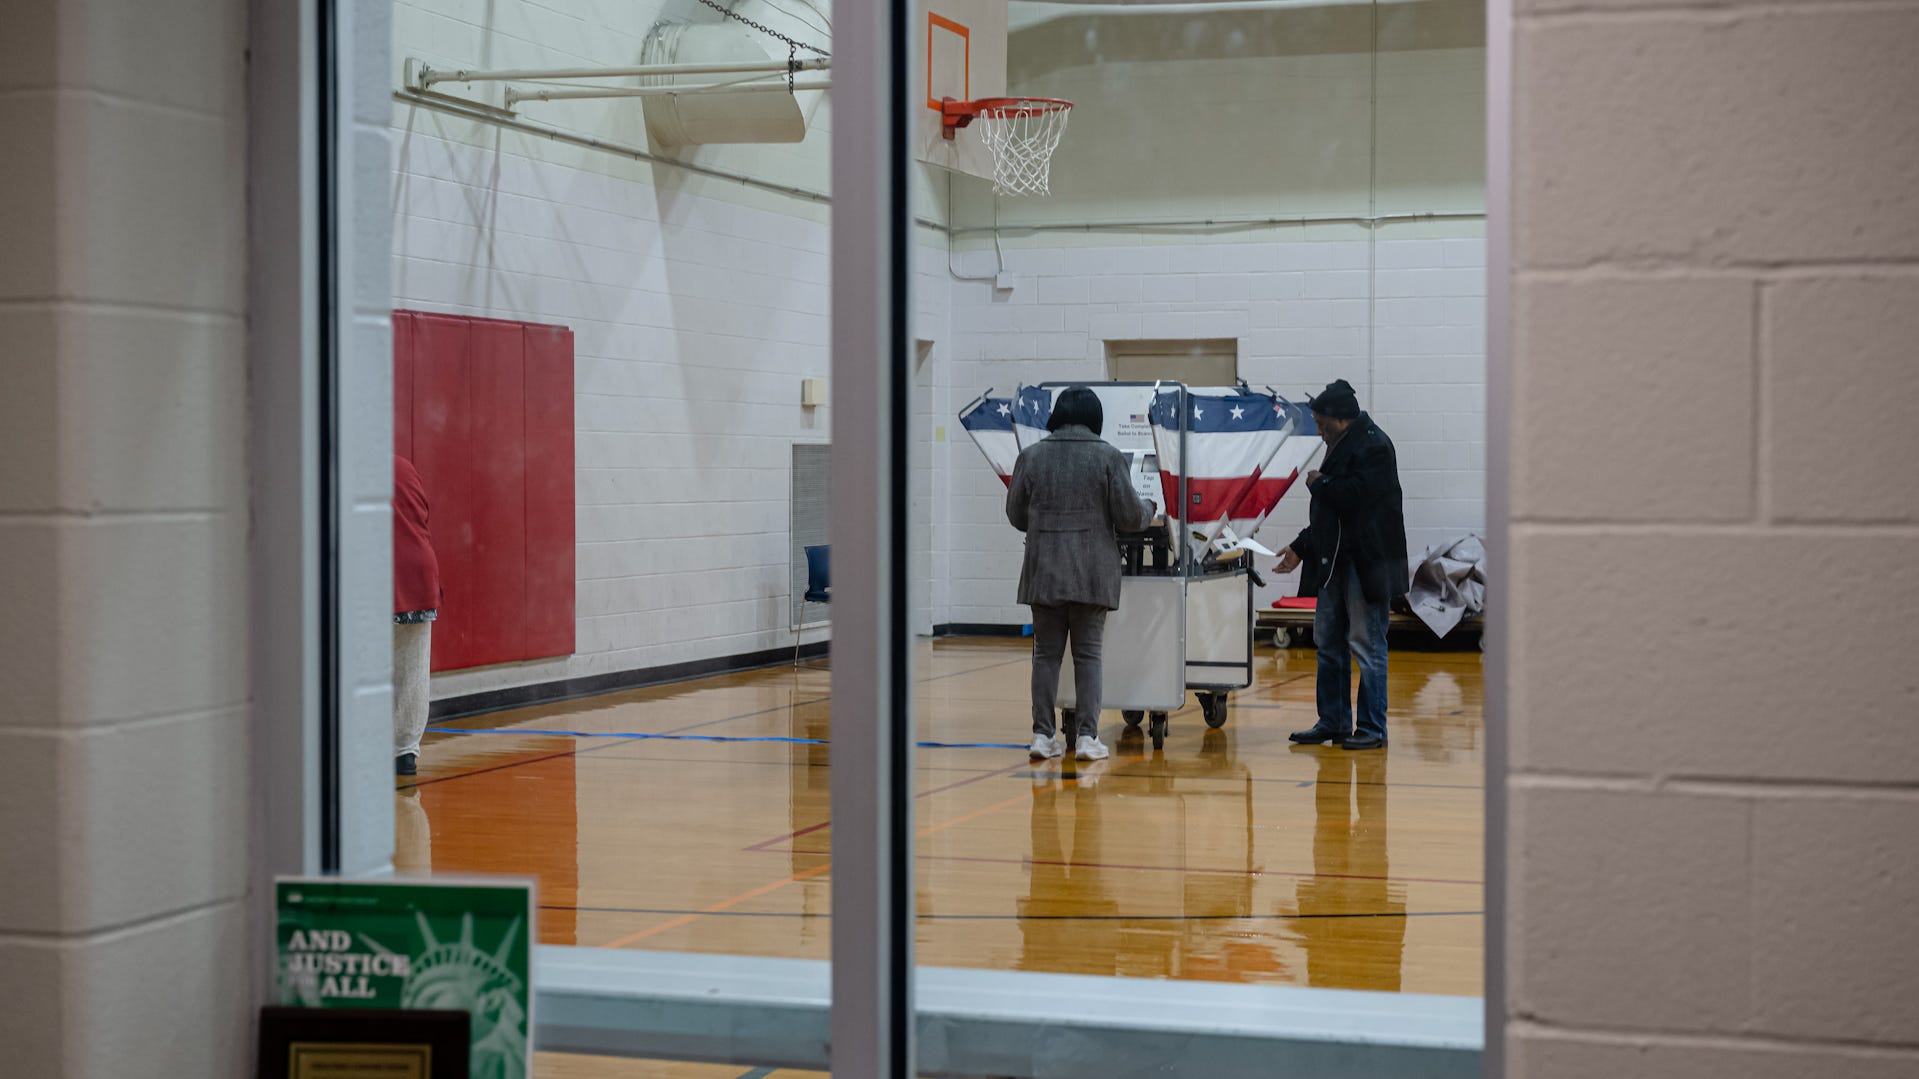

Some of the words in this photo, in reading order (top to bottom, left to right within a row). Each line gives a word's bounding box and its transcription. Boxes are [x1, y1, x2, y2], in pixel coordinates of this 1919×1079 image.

[1143, 474, 1154, 482] Tap
[288, 930, 351, 951] AND
[288, 954, 410, 976] JUSTICE
[320, 976, 376, 998] ALL
